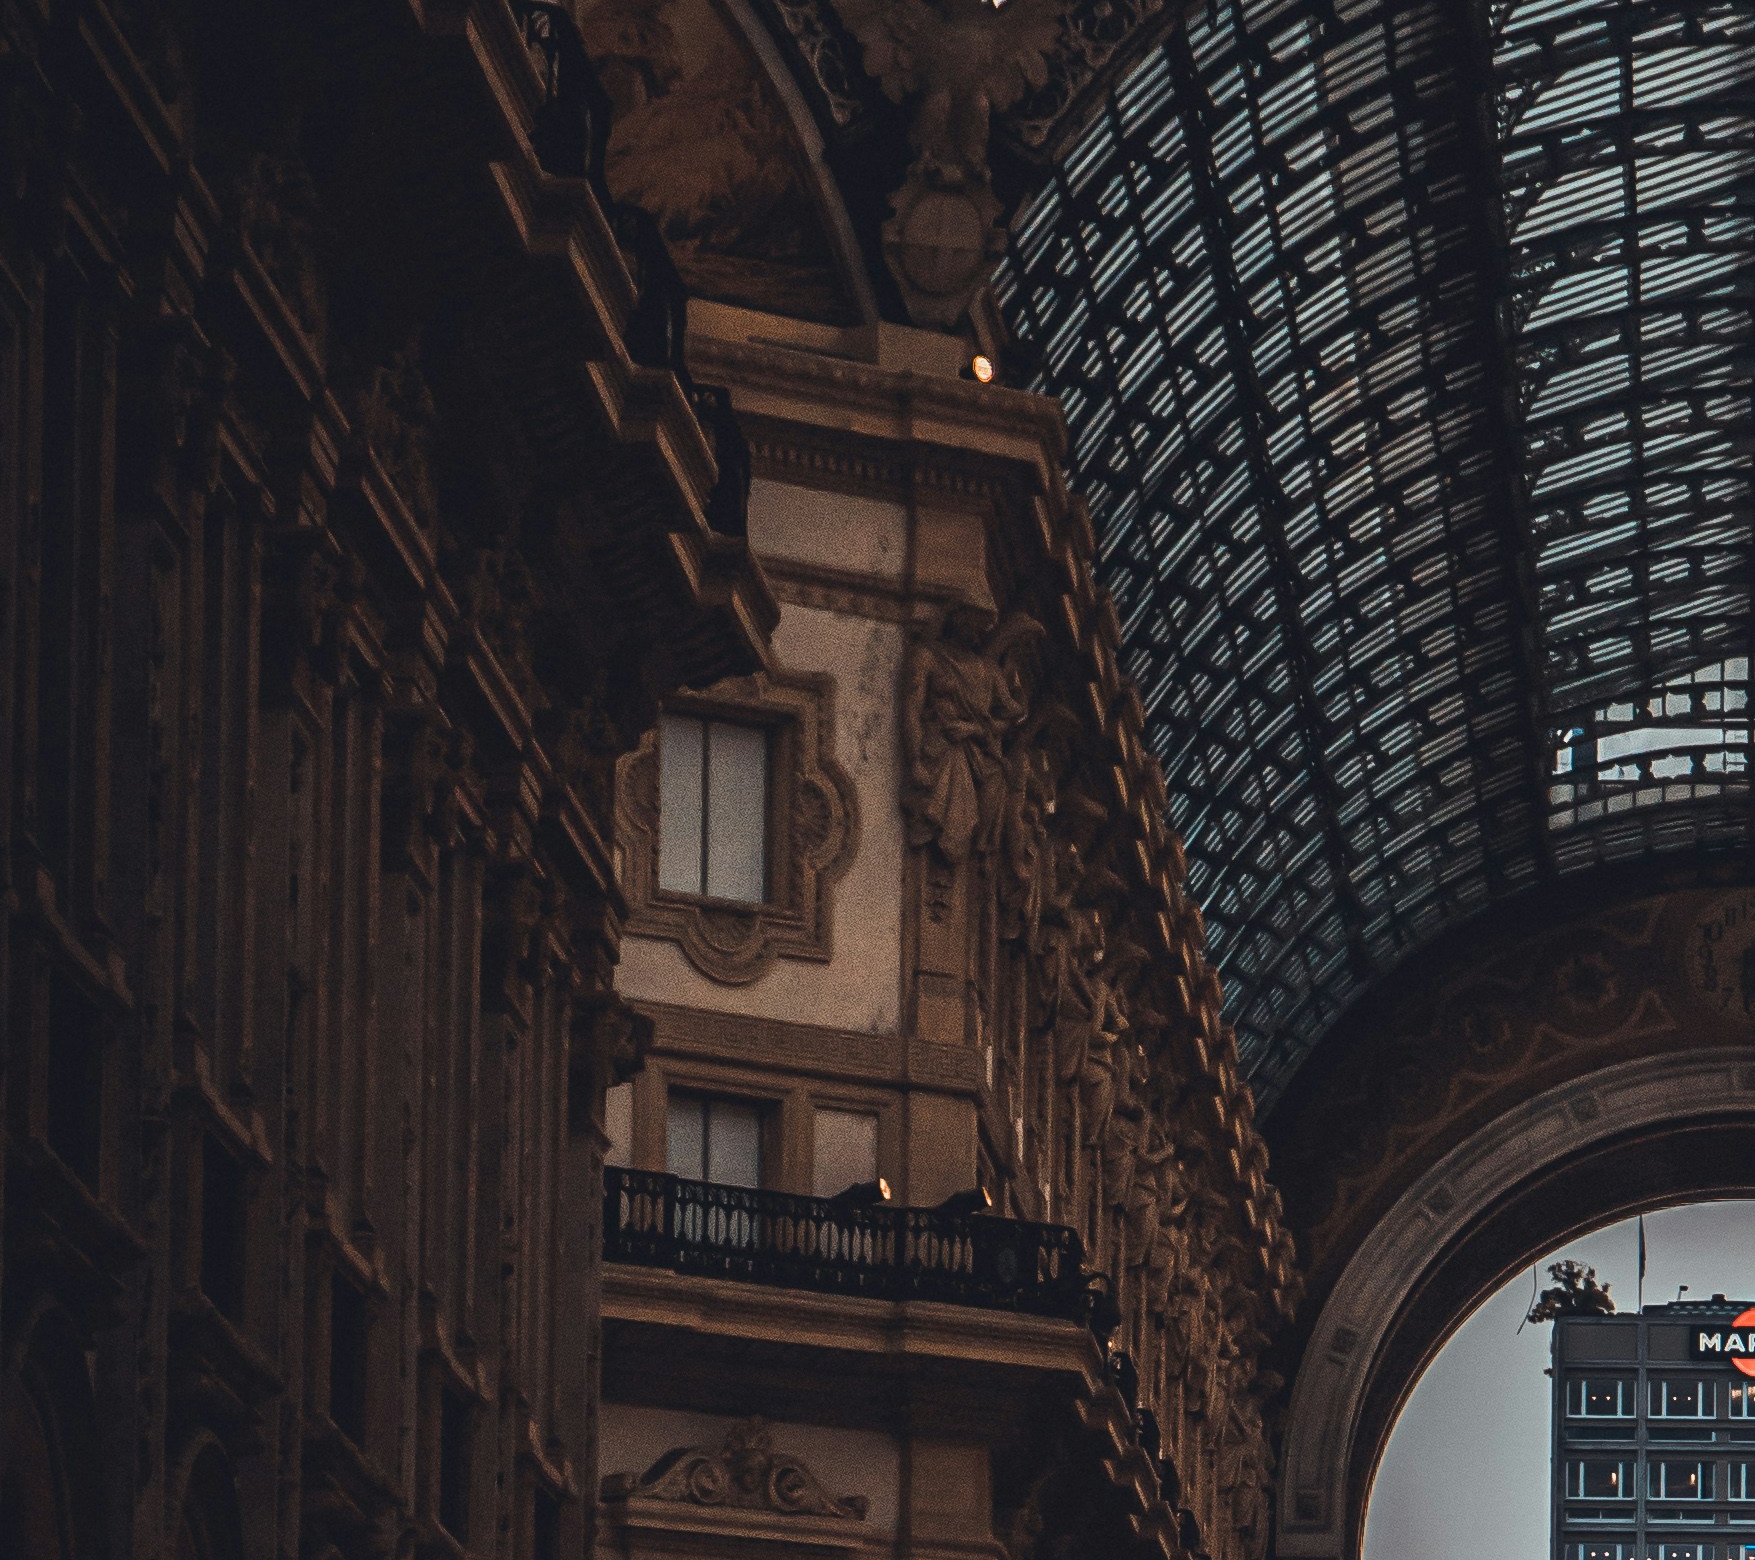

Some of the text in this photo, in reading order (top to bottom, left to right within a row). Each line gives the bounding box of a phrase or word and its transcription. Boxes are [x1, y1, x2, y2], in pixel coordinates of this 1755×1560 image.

[1724, 907, 1737, 927] 11
[1697, 920, 1723, 942] 10
[1698, 942, 1713, 965] 9
[1719, 986, 1734, 1012] 7
